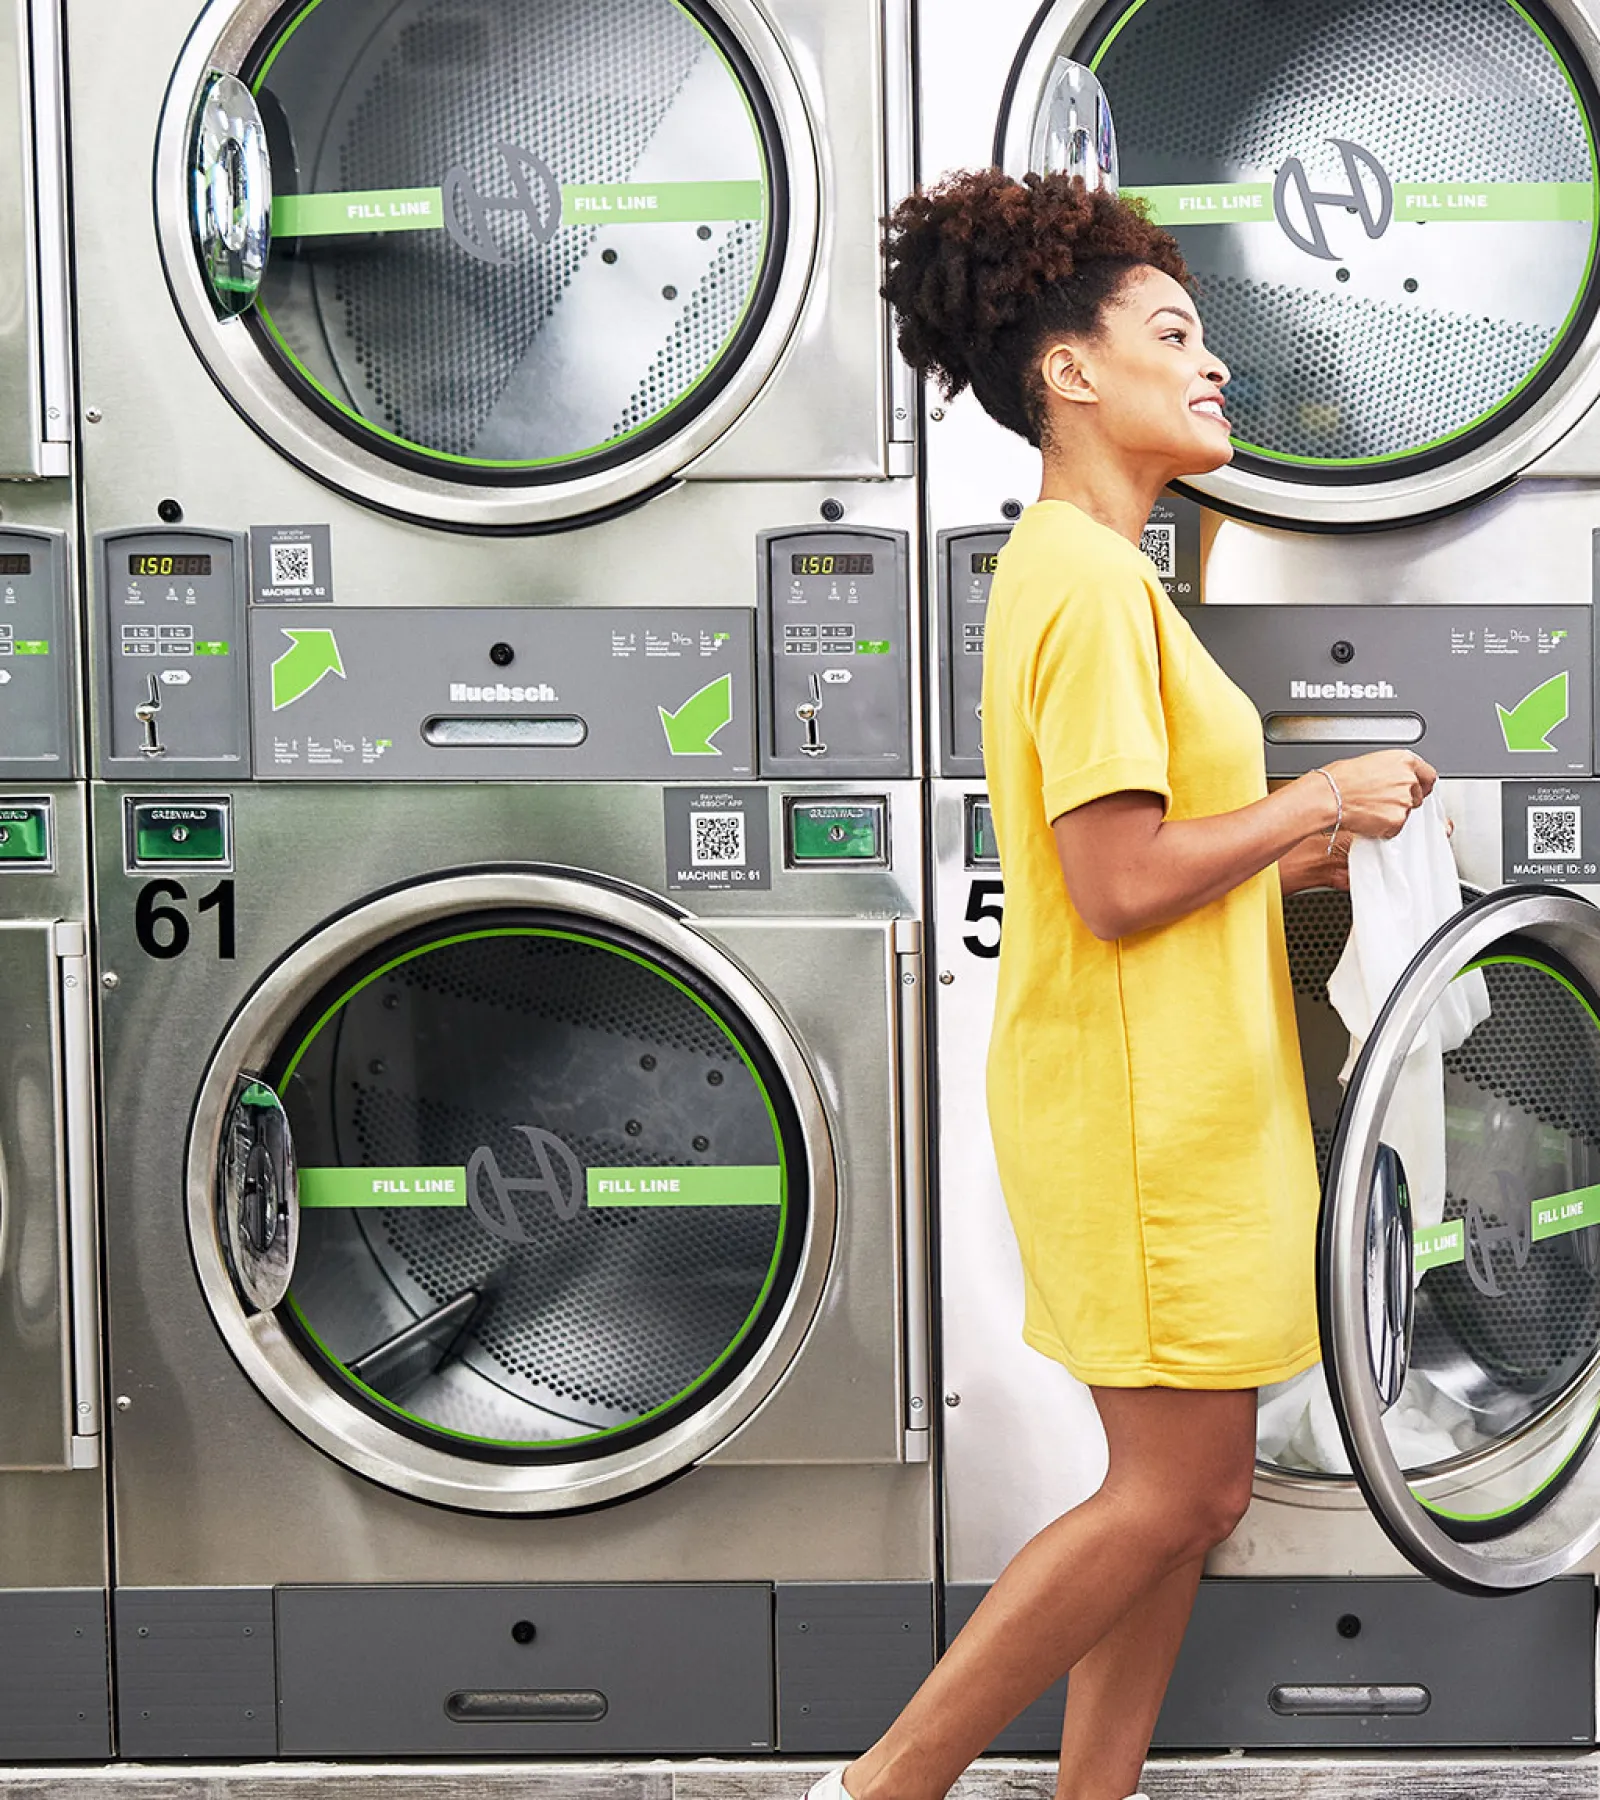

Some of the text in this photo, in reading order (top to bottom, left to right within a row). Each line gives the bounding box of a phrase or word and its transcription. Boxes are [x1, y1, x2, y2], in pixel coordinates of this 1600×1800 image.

[574, 198, 658, 213] FILL LINE
[1179, 195, 1263, 210] FILL LINE
[1406, 194, 1488, 208] FILL LINE
[348, 202, 431, 218] FILL LINE
[1164, 582, 1191, 593] D: 60
[678, 870, 760, 881] MACHINE ID: 61
[1513, 864, 1597, 874] MACHINE ID: 59
[136, 879, 235, 960] 61
[964, 880, 1002, 959] 5
[373, 1180, 455, 1193] FILL LINE
[599, 1180, 680, 1193] FILL LINE
[1538, 1200, 1584, 1225] FILL LINE
[1434, 1233, 1458, 1252] LINE
